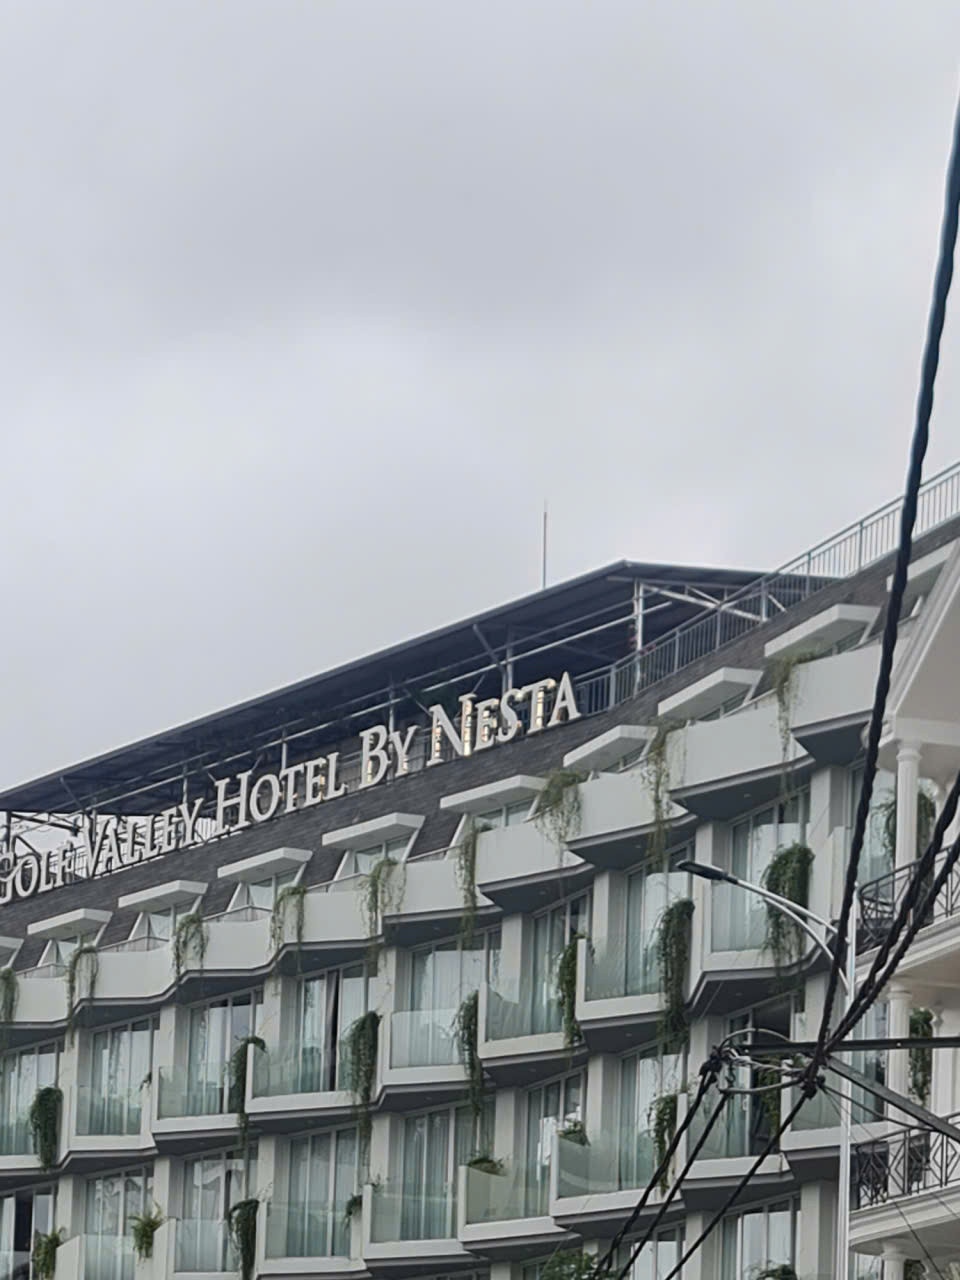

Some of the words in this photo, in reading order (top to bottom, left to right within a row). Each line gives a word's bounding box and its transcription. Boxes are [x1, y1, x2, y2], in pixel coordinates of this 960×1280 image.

[80, 797, 204, 878] VALLEY
[214, 751, 349, 836] HOTEL
[358, 724, 421, 790] BY
[426, 670, 583, 768] NESTA
